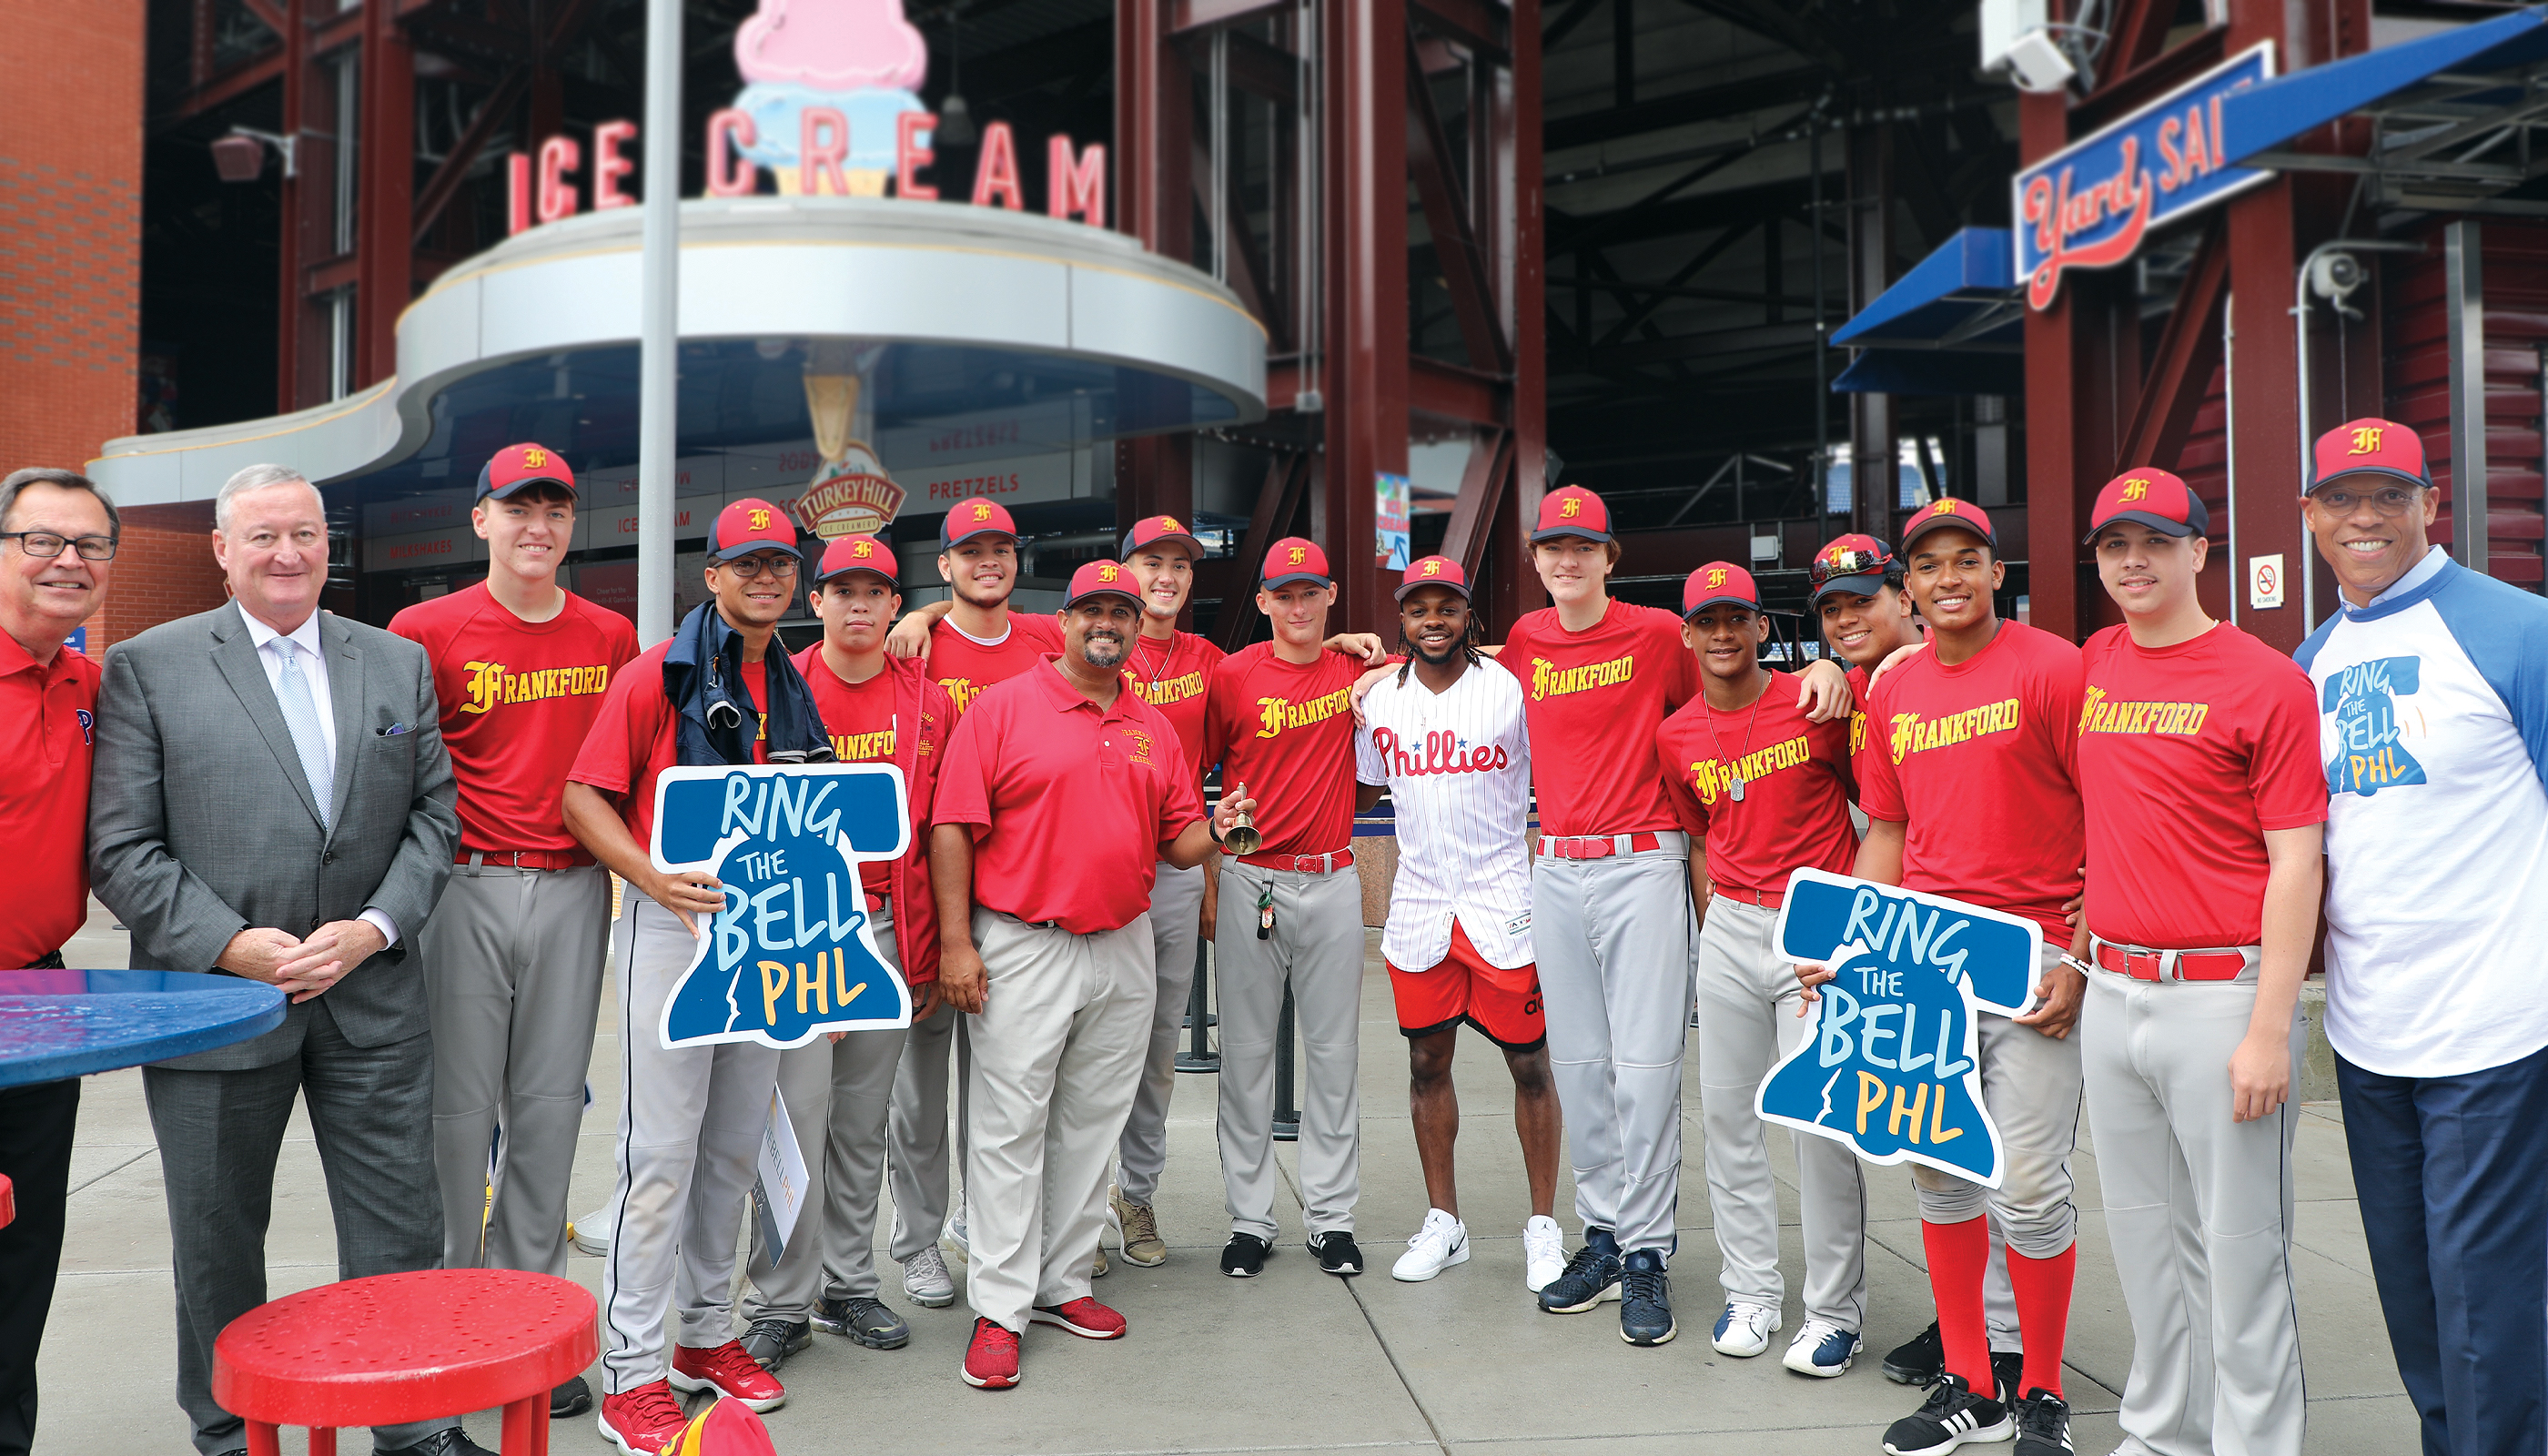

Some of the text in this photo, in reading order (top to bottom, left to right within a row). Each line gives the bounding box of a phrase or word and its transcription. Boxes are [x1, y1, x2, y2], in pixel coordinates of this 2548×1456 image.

[508, 106, 1107, 238] ICE CREAM
[2024, 135, 2152, 310] Yard
[800, 477, 895, 522] TURKEY HILL
[929, 474, 1019, 500] PRETZELS
[389, 538, 452, 560] MILKSHAKES
[618, 516, 639, 533] ICE
[820, 519, 877, 534] ICE CREAMERY
[1376, 514, 1410, 533] CREAM
[459, 661, 609, 714] FRANKFORD
[1530, 655, 1634, 702] FRANKFORD
[2340, 660, 2391, 697] RING
[1890, 698, 2021, 766] FRANKFORD
[2078, 684, 2209, 739] FRANKFORD
[2342, 698, 2367, 718] THE
[1372, 726, 1508, 778] Phillies
[2335, 707, 2400, 763] BELL
[2349, 746, 2407, 790] PHL
[721, 774, 842, 847] RING
[735, 849, 788, 883] THE
[707, 872, 862, 972] BELL
[1843, 888, 1970, 984] RING
[757, 946, 867, 1026] PHL
[1853, 966, 1904, 997] THE
[1819, 984, 1970, 1080] BELL
[1855, 1070, 1964, 1145] PHL
